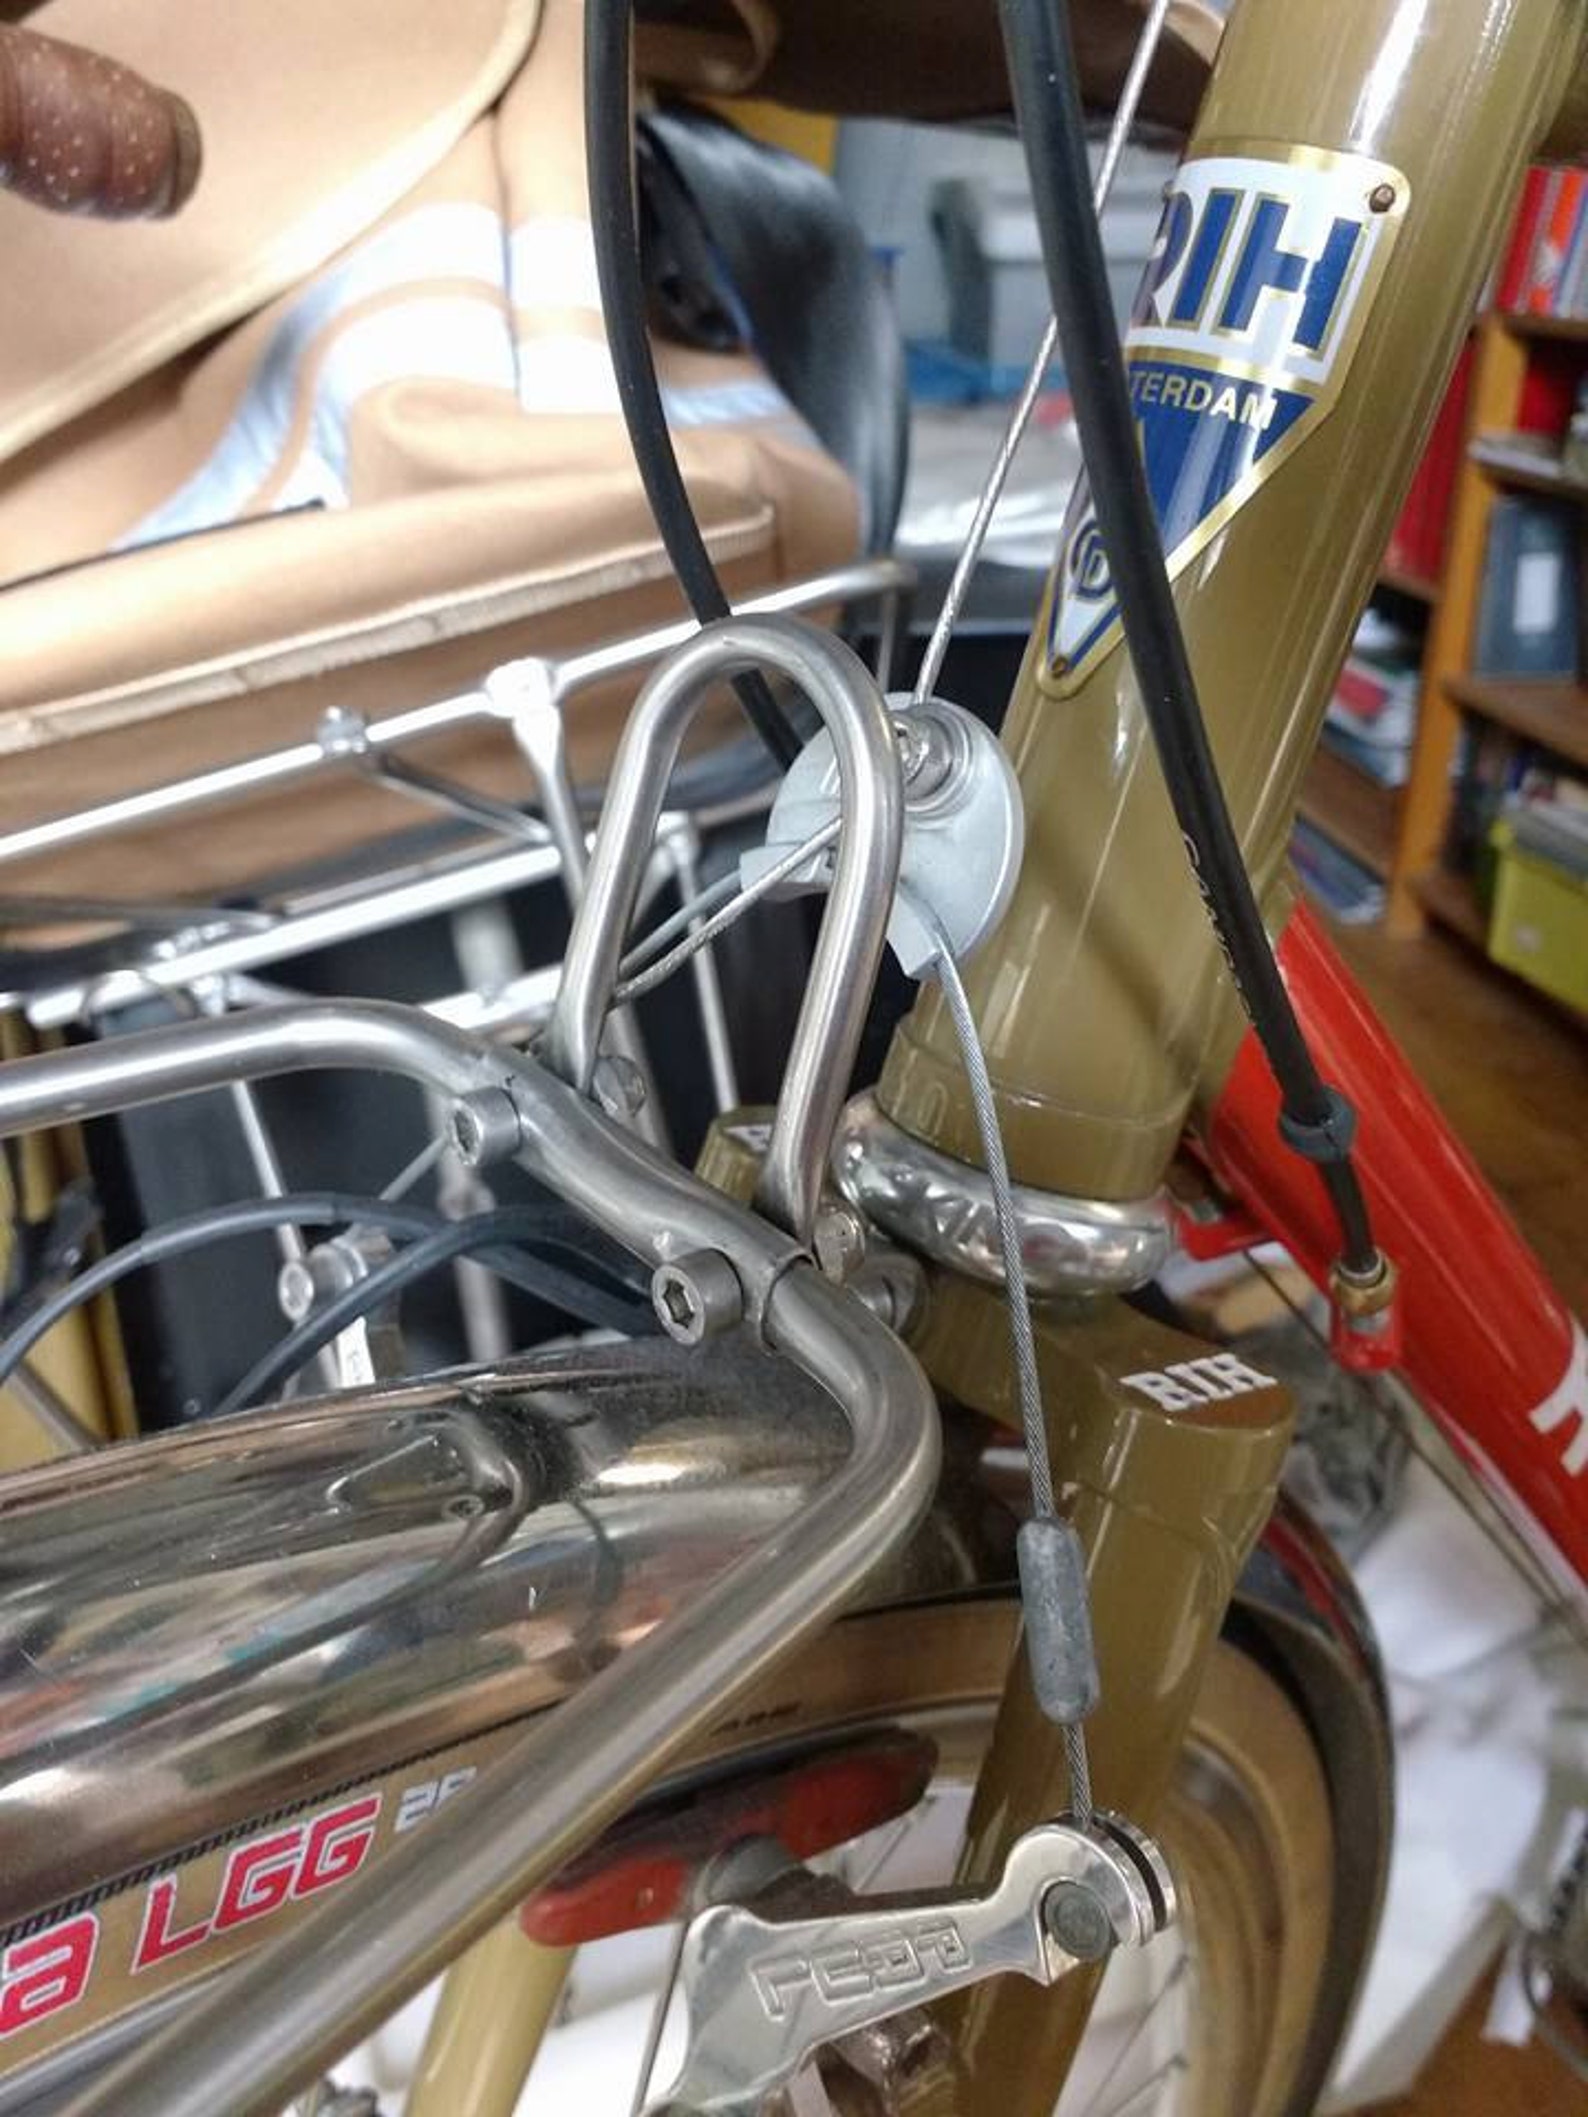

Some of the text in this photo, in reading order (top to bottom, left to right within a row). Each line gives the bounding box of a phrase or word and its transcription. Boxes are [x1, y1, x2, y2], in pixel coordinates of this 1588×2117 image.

[1131, 187, 1368, 362] RIH
[1119, 1353, 1278, 1412] RIH
[130, 1792, 383, 1976] LGG
